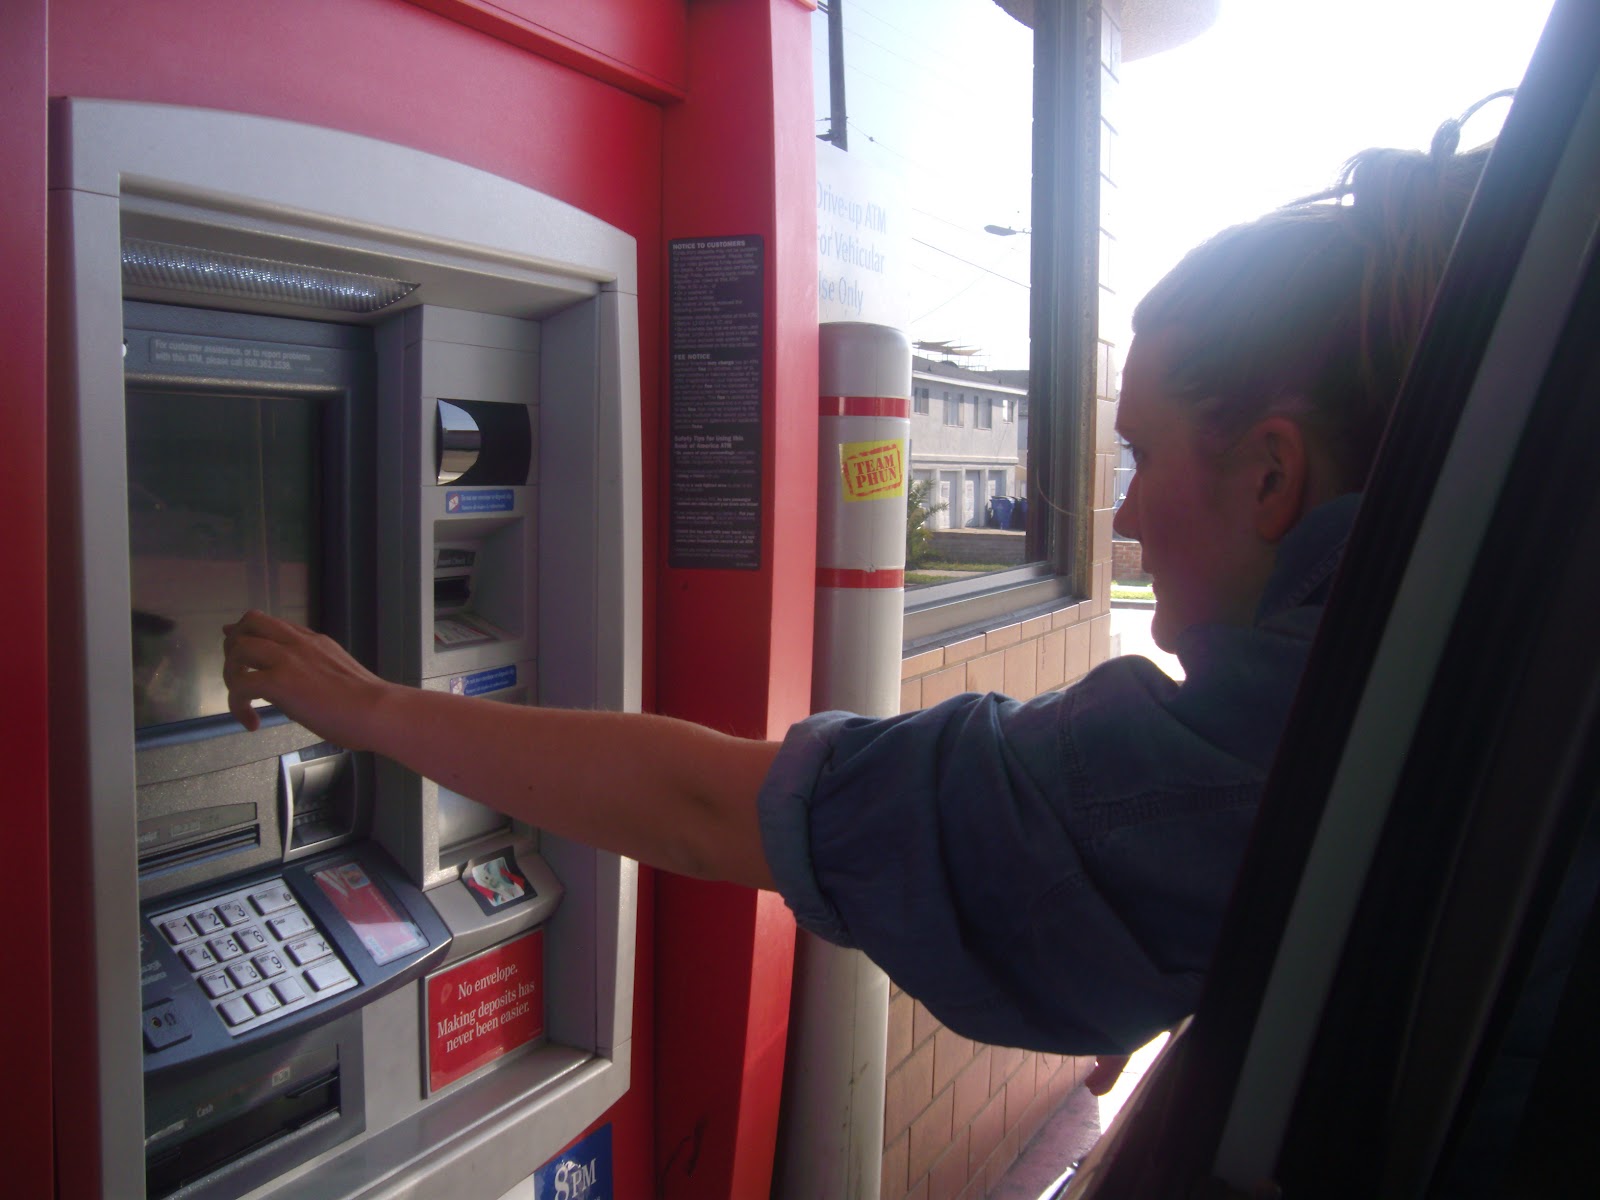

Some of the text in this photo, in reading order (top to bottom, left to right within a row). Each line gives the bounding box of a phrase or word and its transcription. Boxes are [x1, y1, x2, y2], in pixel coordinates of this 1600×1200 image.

[865, 201, 887, 235] ATM
[707, 240, 746, 248] CUSTOMERS
[817, 226, 885, 274] or Vehicular
[838, 276, 864, 316] Only
[853, 454, 895, 476] TEAM
[855, 467, 897, 489] PHUN
[234, 904, 246, 917] 3
[208, 913, 220, 926] 2
[182, 922, 194, 935] 1
[252, 930, 264, 943] 6
[227, 939, 238, 952] 5
[202, 948, 212, 960] 4
[271, 956, 282, 969] 9
[218, 974, 229, 988] 7
[457, 963, 518, 1000] No envelope.
[437, 980, 535, 1038] Making deposits has
[446, 1001, 530, 1053] never been easier.
